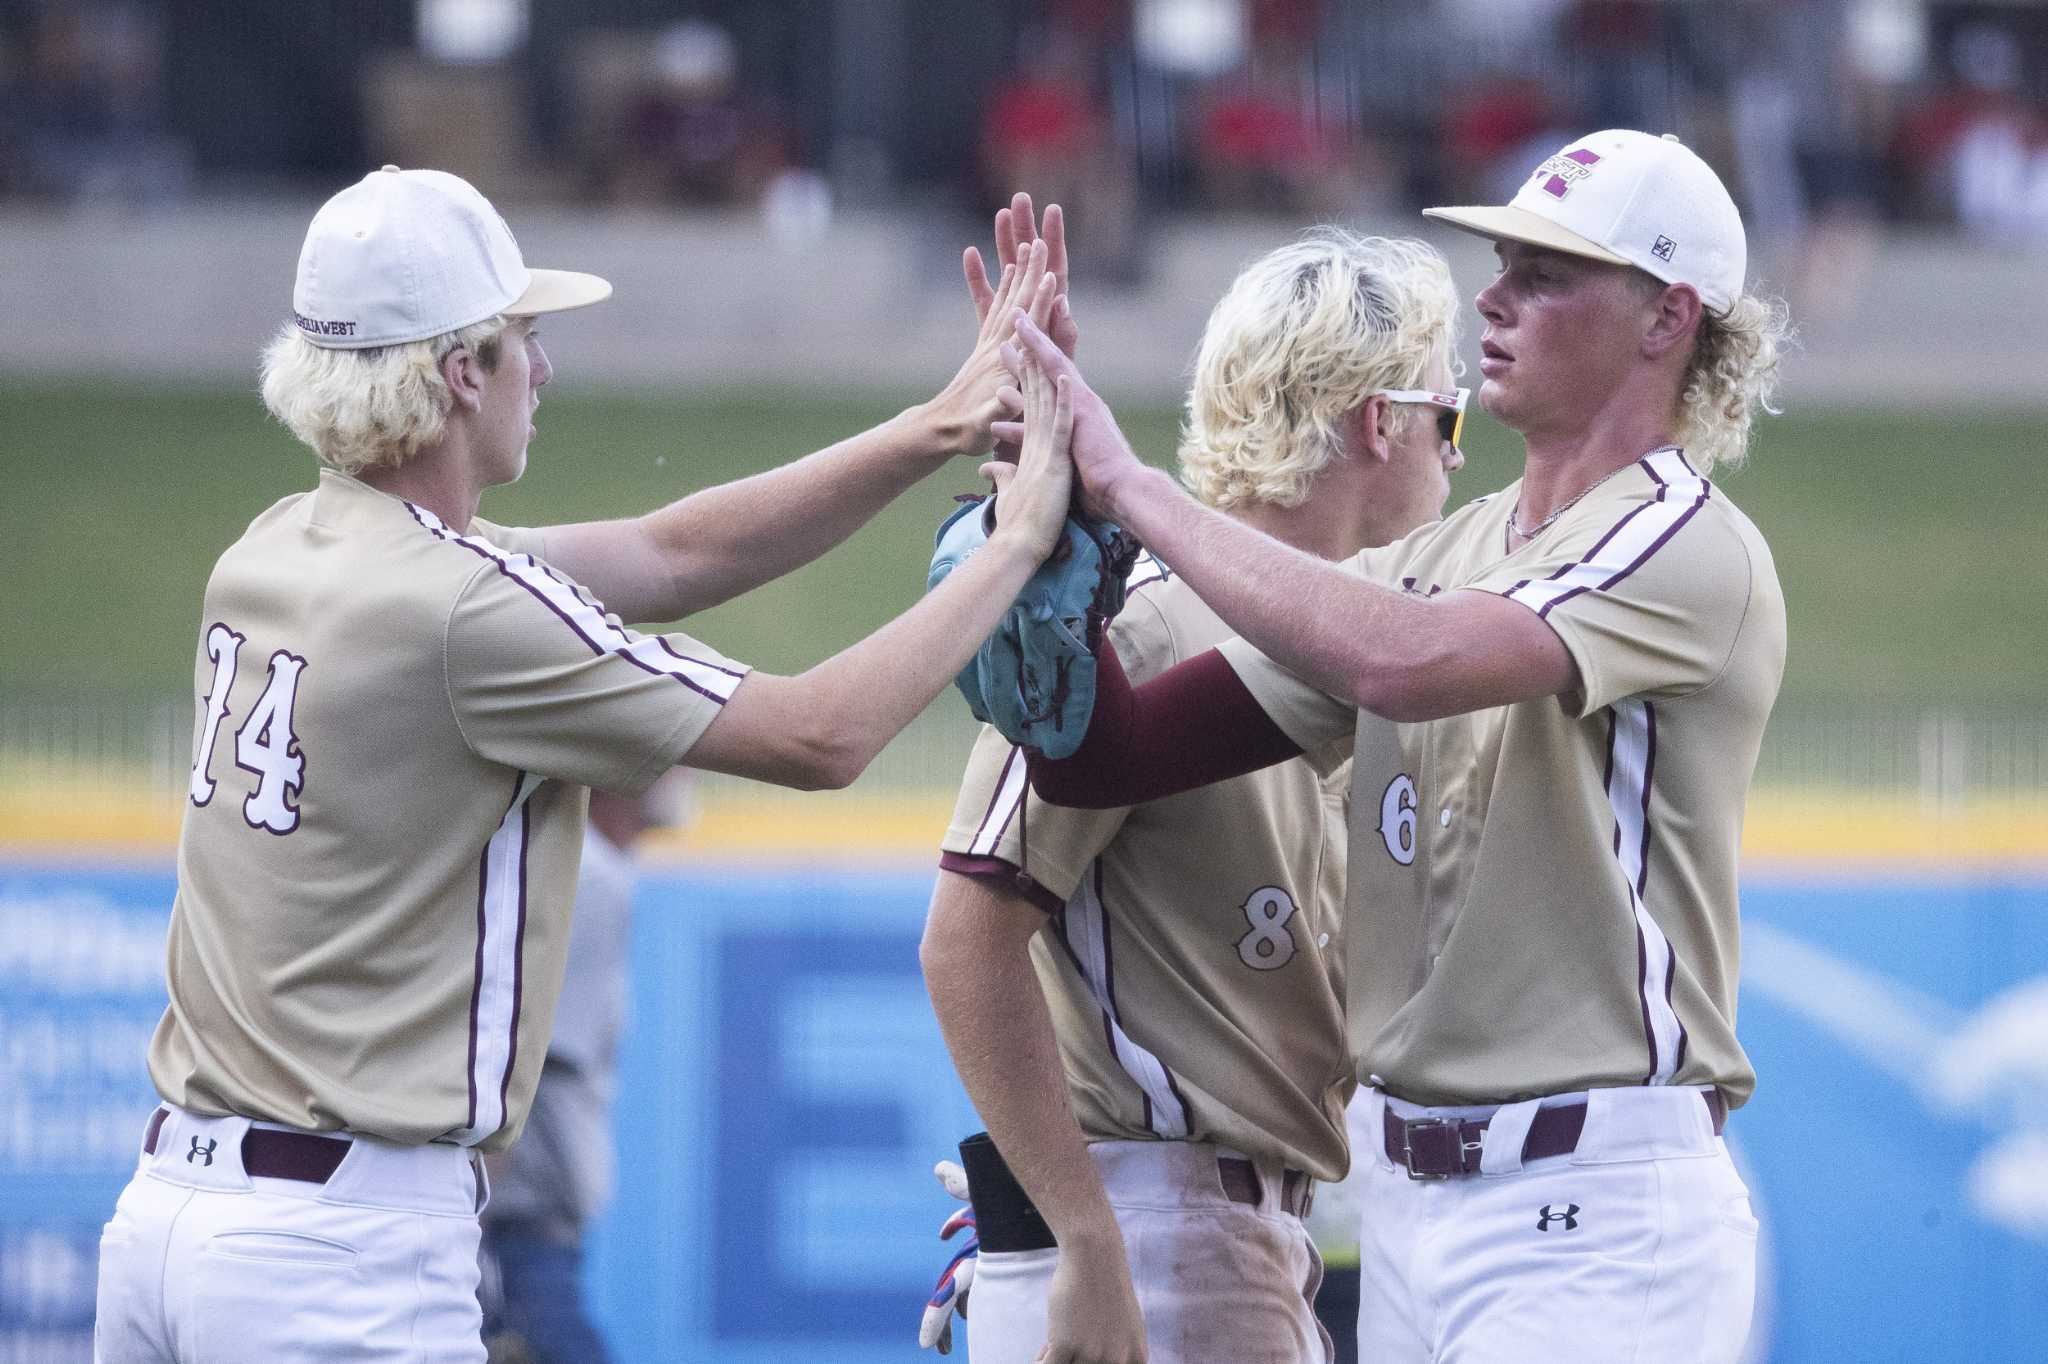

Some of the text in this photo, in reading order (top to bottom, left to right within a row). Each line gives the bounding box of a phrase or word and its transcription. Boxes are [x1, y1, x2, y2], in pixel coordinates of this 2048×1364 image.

[191, 622, 308, 836] 14
[1375, 772, 1418, 866] 6
[1232, 884, 1300, 971] 8
